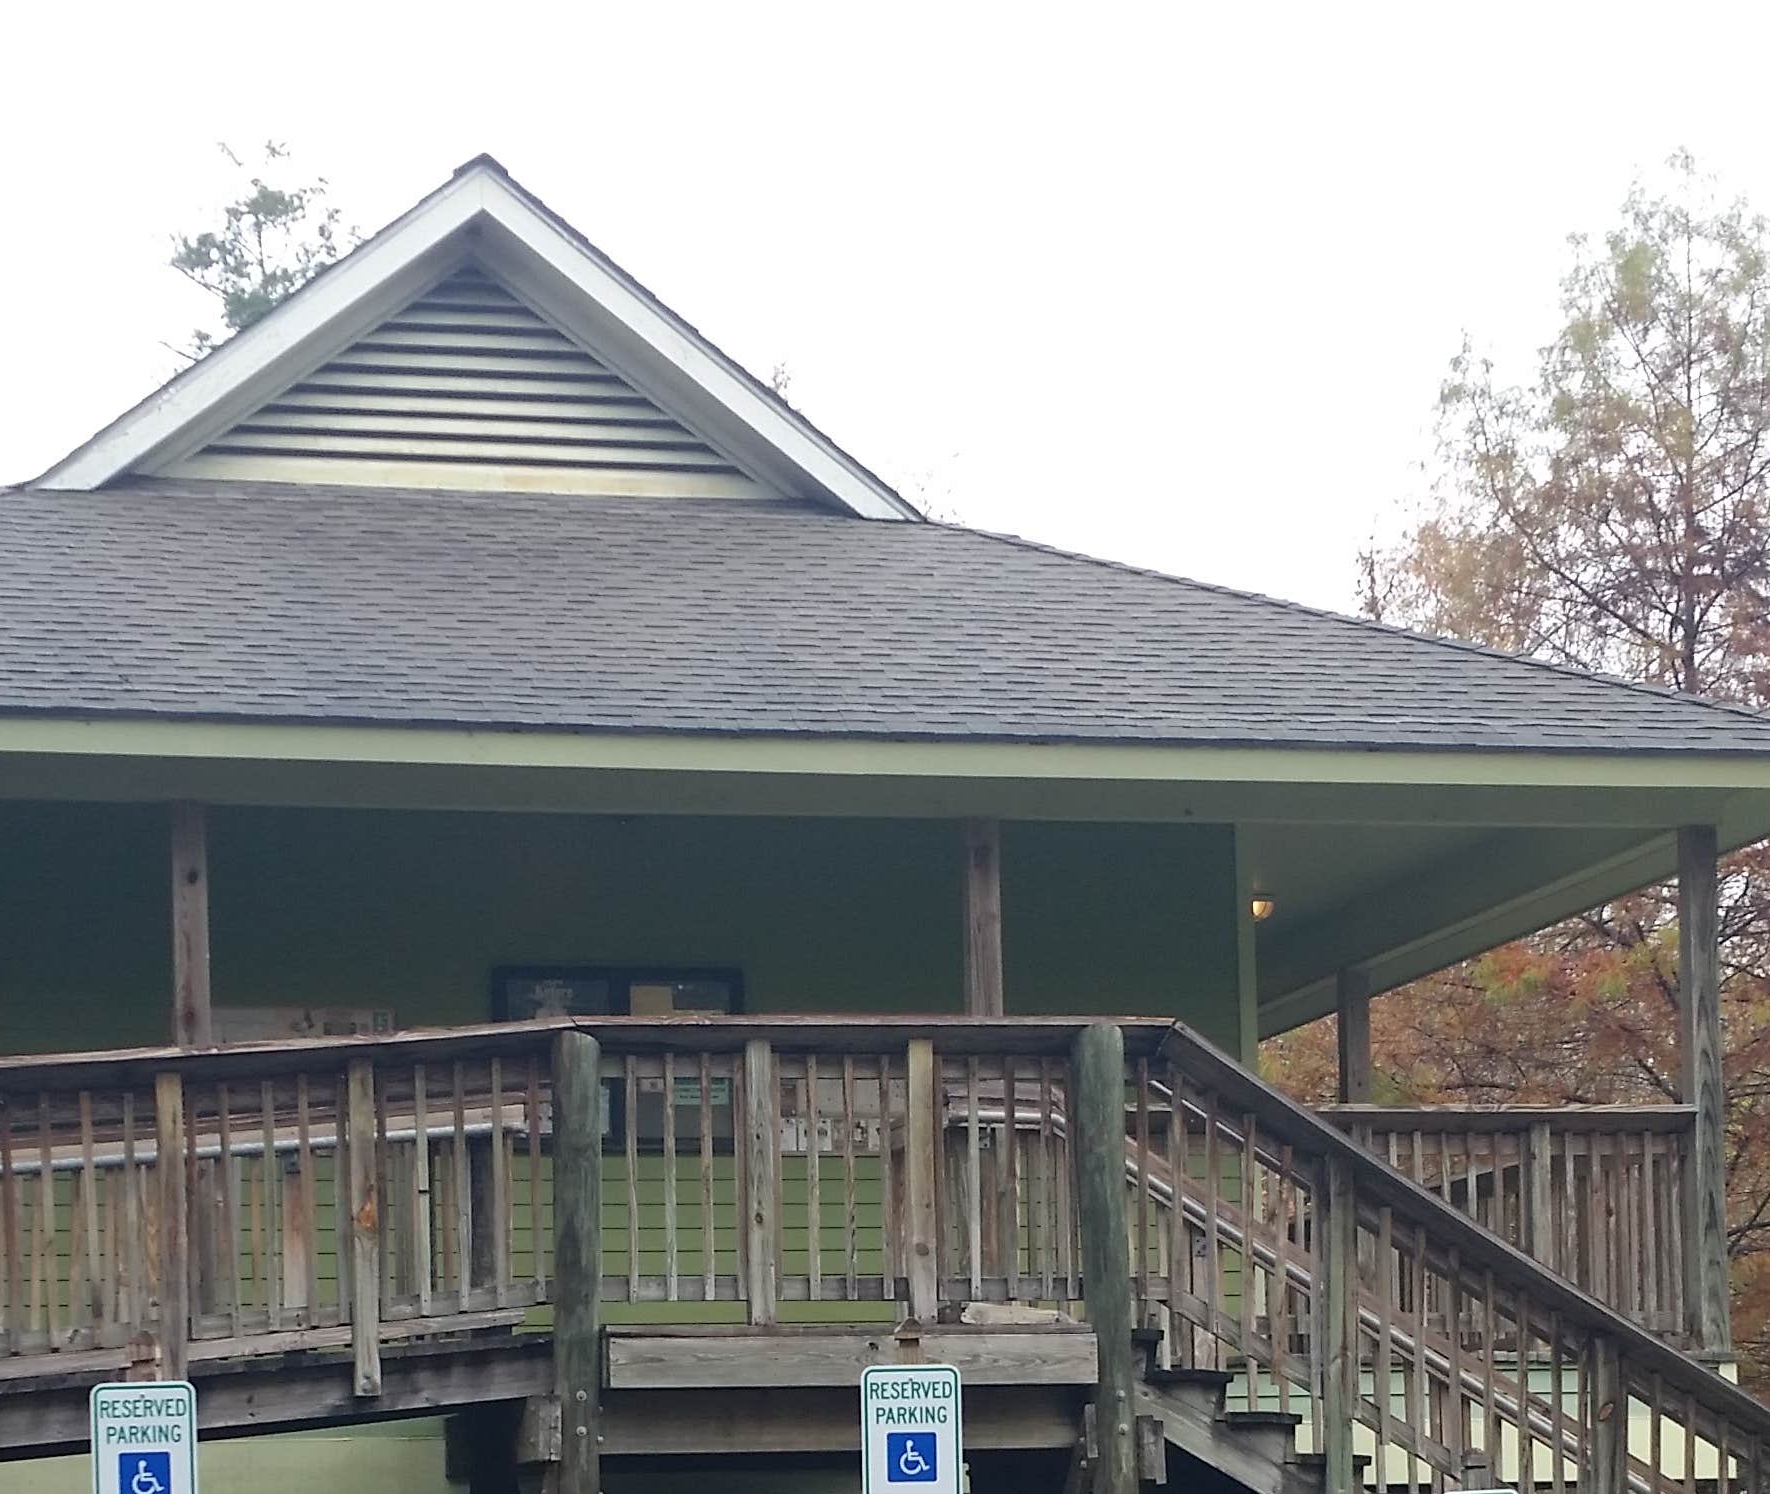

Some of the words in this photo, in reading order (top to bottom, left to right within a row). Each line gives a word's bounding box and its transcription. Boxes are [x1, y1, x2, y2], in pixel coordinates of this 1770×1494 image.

[869, 1381, 952, 1400] RESERVED
[100, 1398, 187, 1418] RESERVED
[875, 1406, 948, 1425] PARKING
[106, 1424, 182, 1444] PARKING
